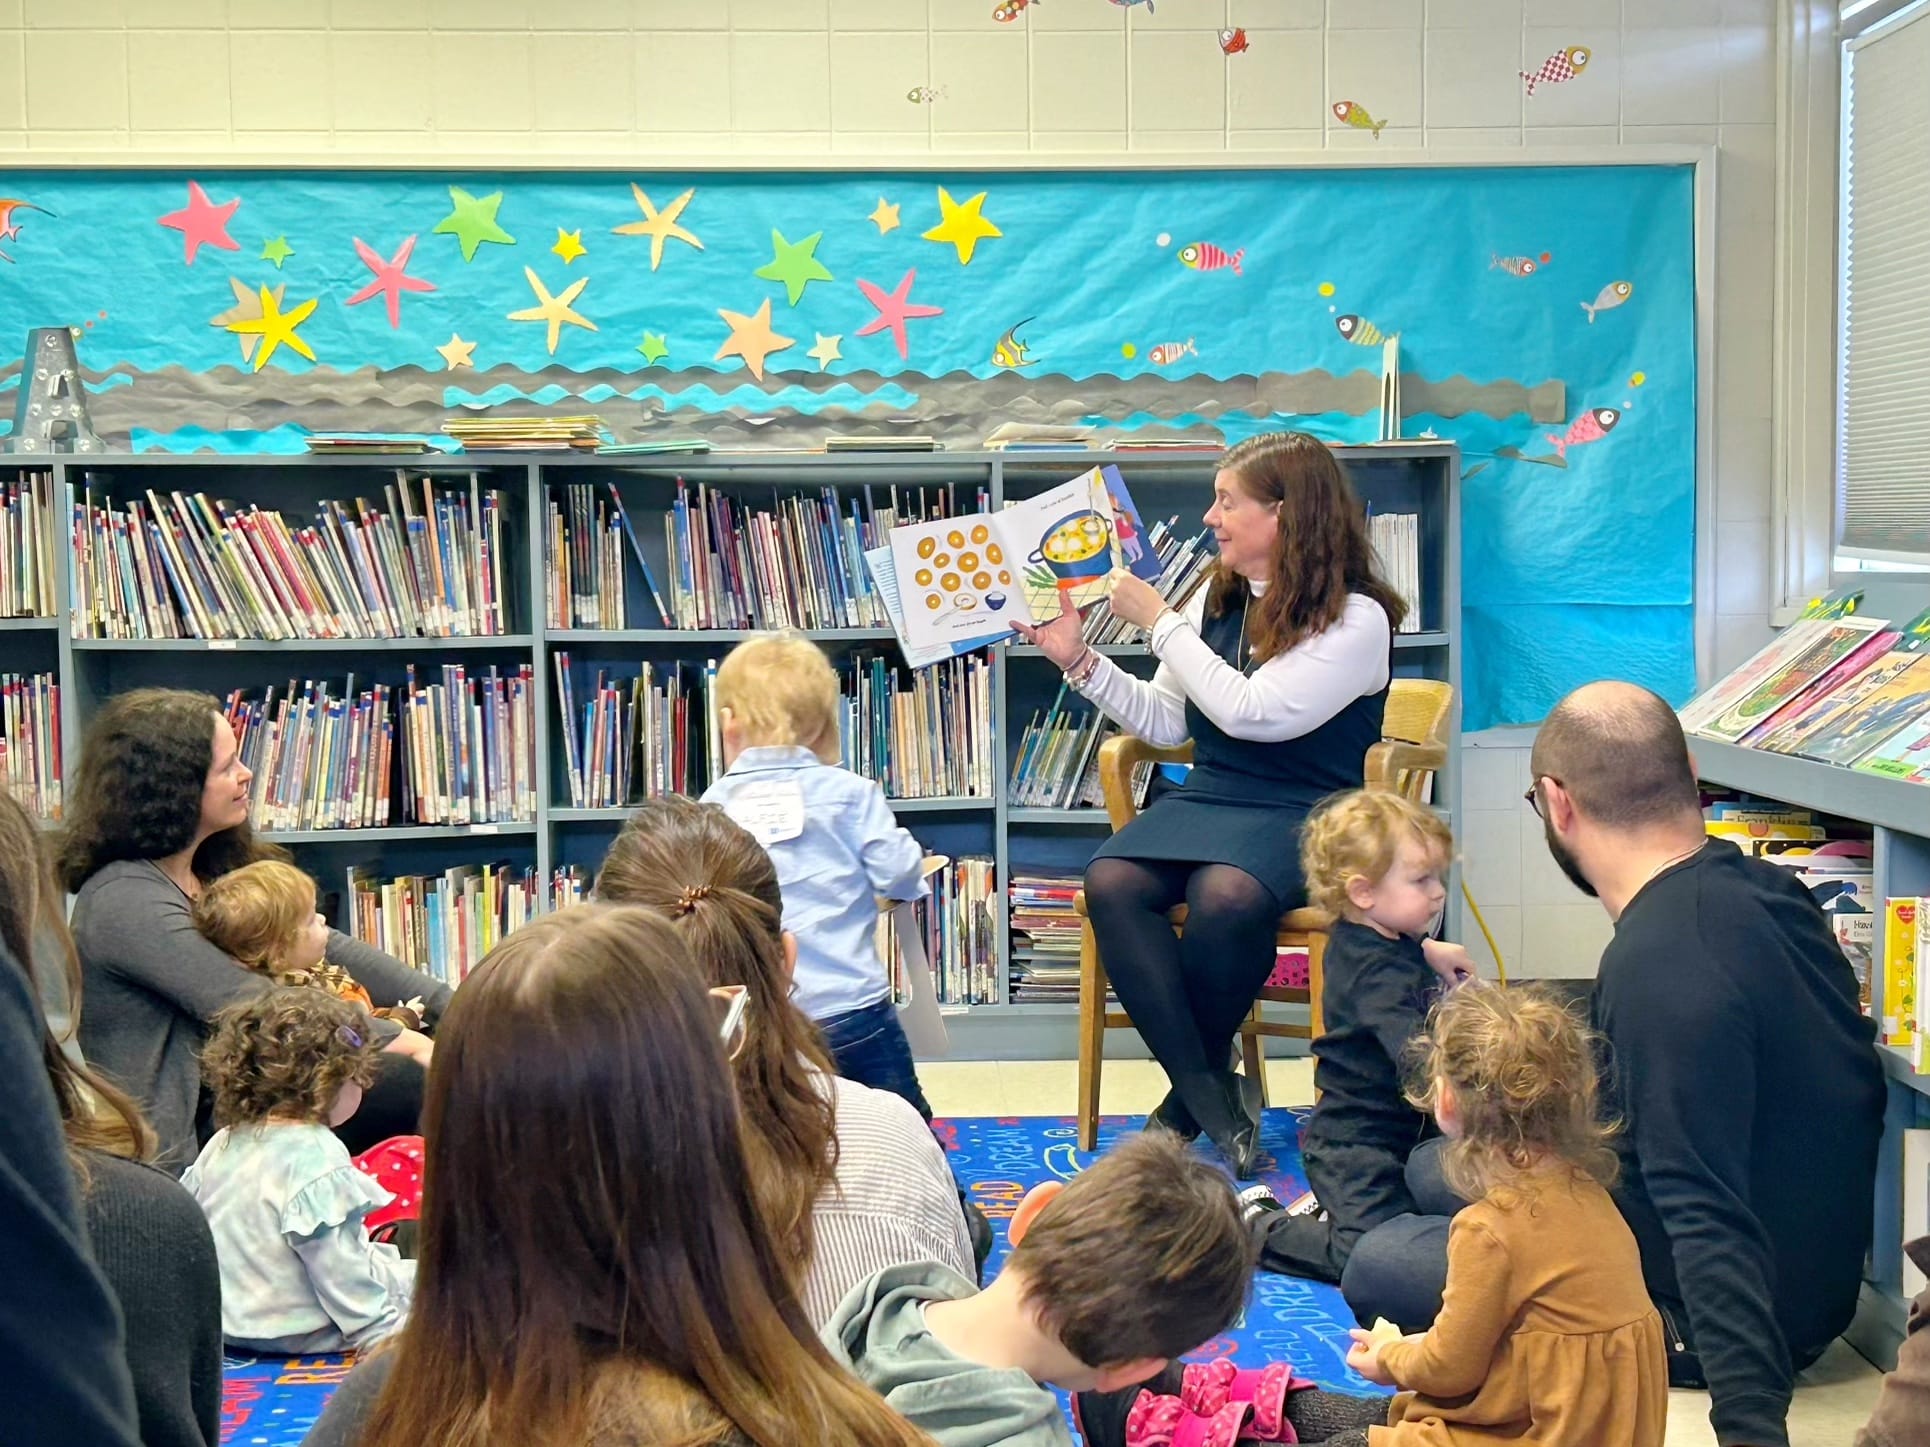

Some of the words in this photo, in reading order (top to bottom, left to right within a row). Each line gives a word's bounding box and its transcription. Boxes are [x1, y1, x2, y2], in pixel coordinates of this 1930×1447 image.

[986, 1128, 1041, 1169] DREAM
[970, 1181, 1025, 1218] READ
[1255, 1273, 1334, 1322] DREA
